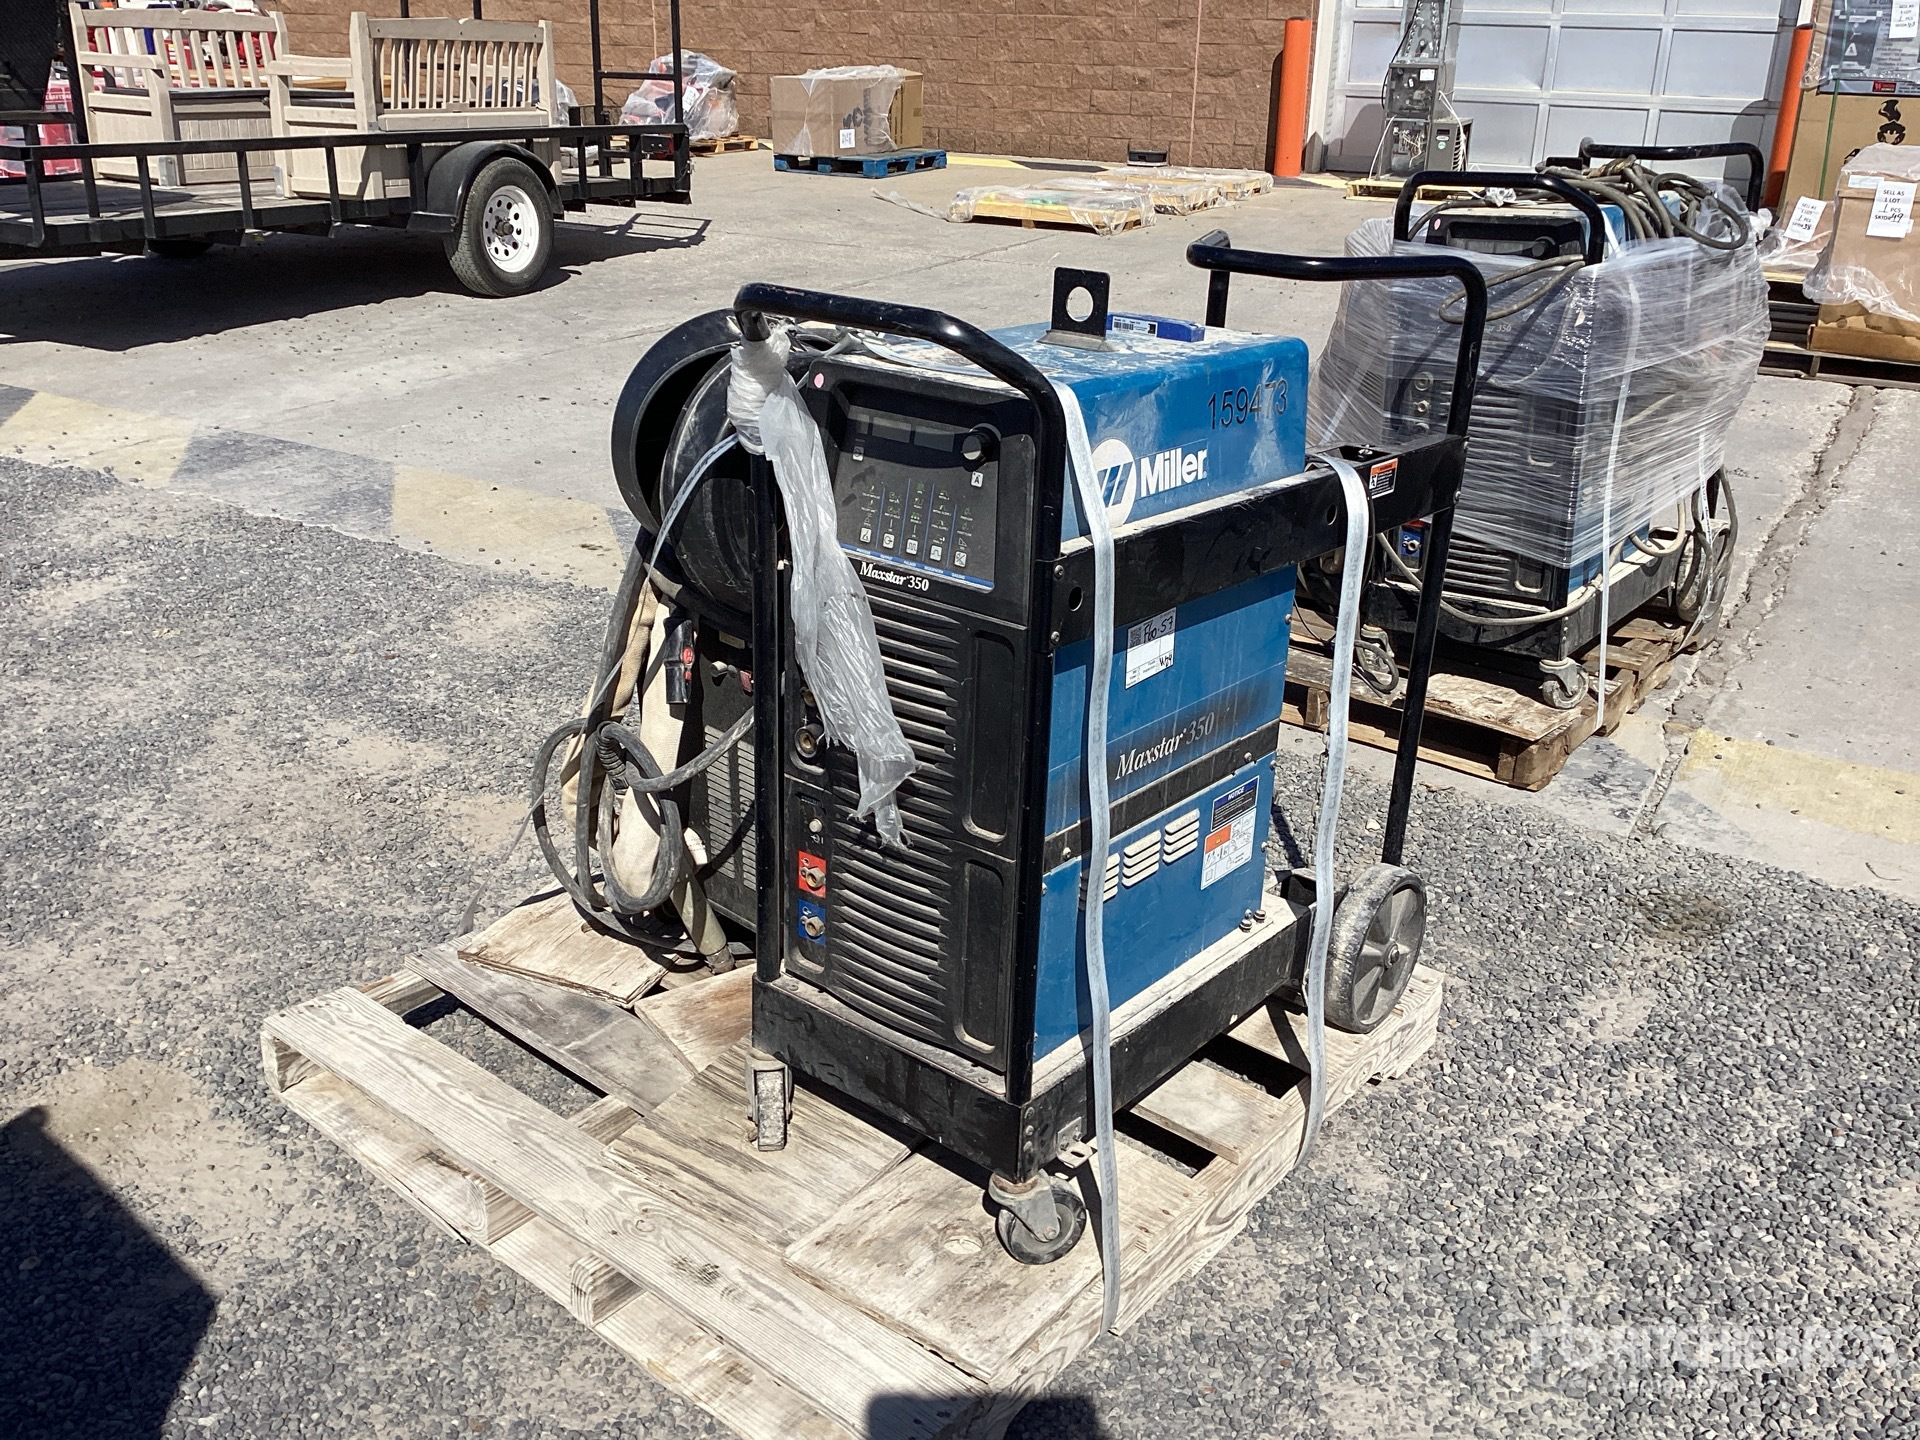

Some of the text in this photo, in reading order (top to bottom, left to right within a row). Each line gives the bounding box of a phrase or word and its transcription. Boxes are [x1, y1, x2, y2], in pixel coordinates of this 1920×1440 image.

[1207, 379, 1288, 430] 159473
[1140, 447, 1208, 498] Miller
[860, 561, 930, 591] Maxstar 350
[1115, 712, 1215, 781] Maxstar 350
[1227, 786, 1245, 801] NOTICE
